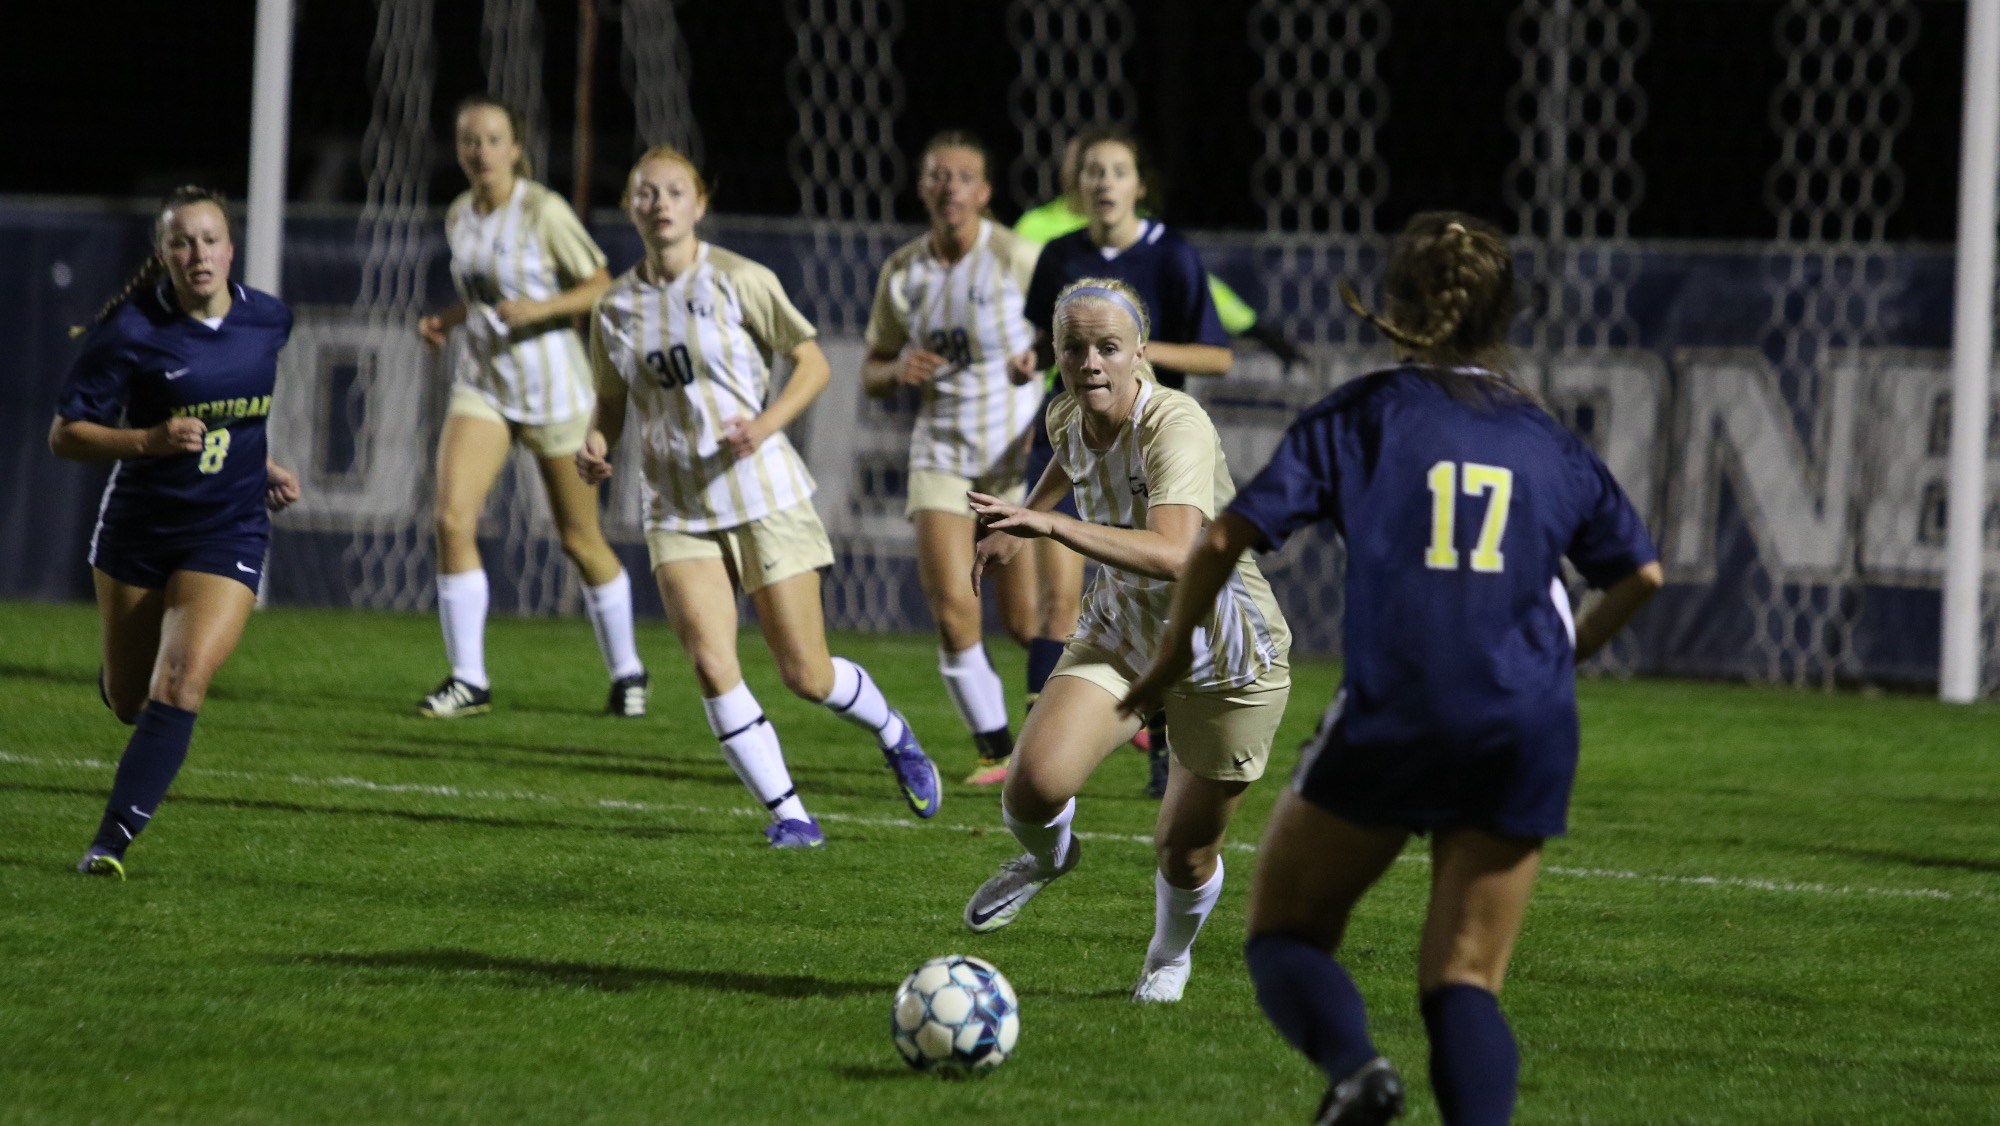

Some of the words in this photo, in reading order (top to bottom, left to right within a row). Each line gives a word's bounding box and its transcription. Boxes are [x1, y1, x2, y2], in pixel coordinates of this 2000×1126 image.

[646, 342, 695, 389] 30
[198, 428, 231, 474] 8
[1424, 460, 1513, 573] 17
